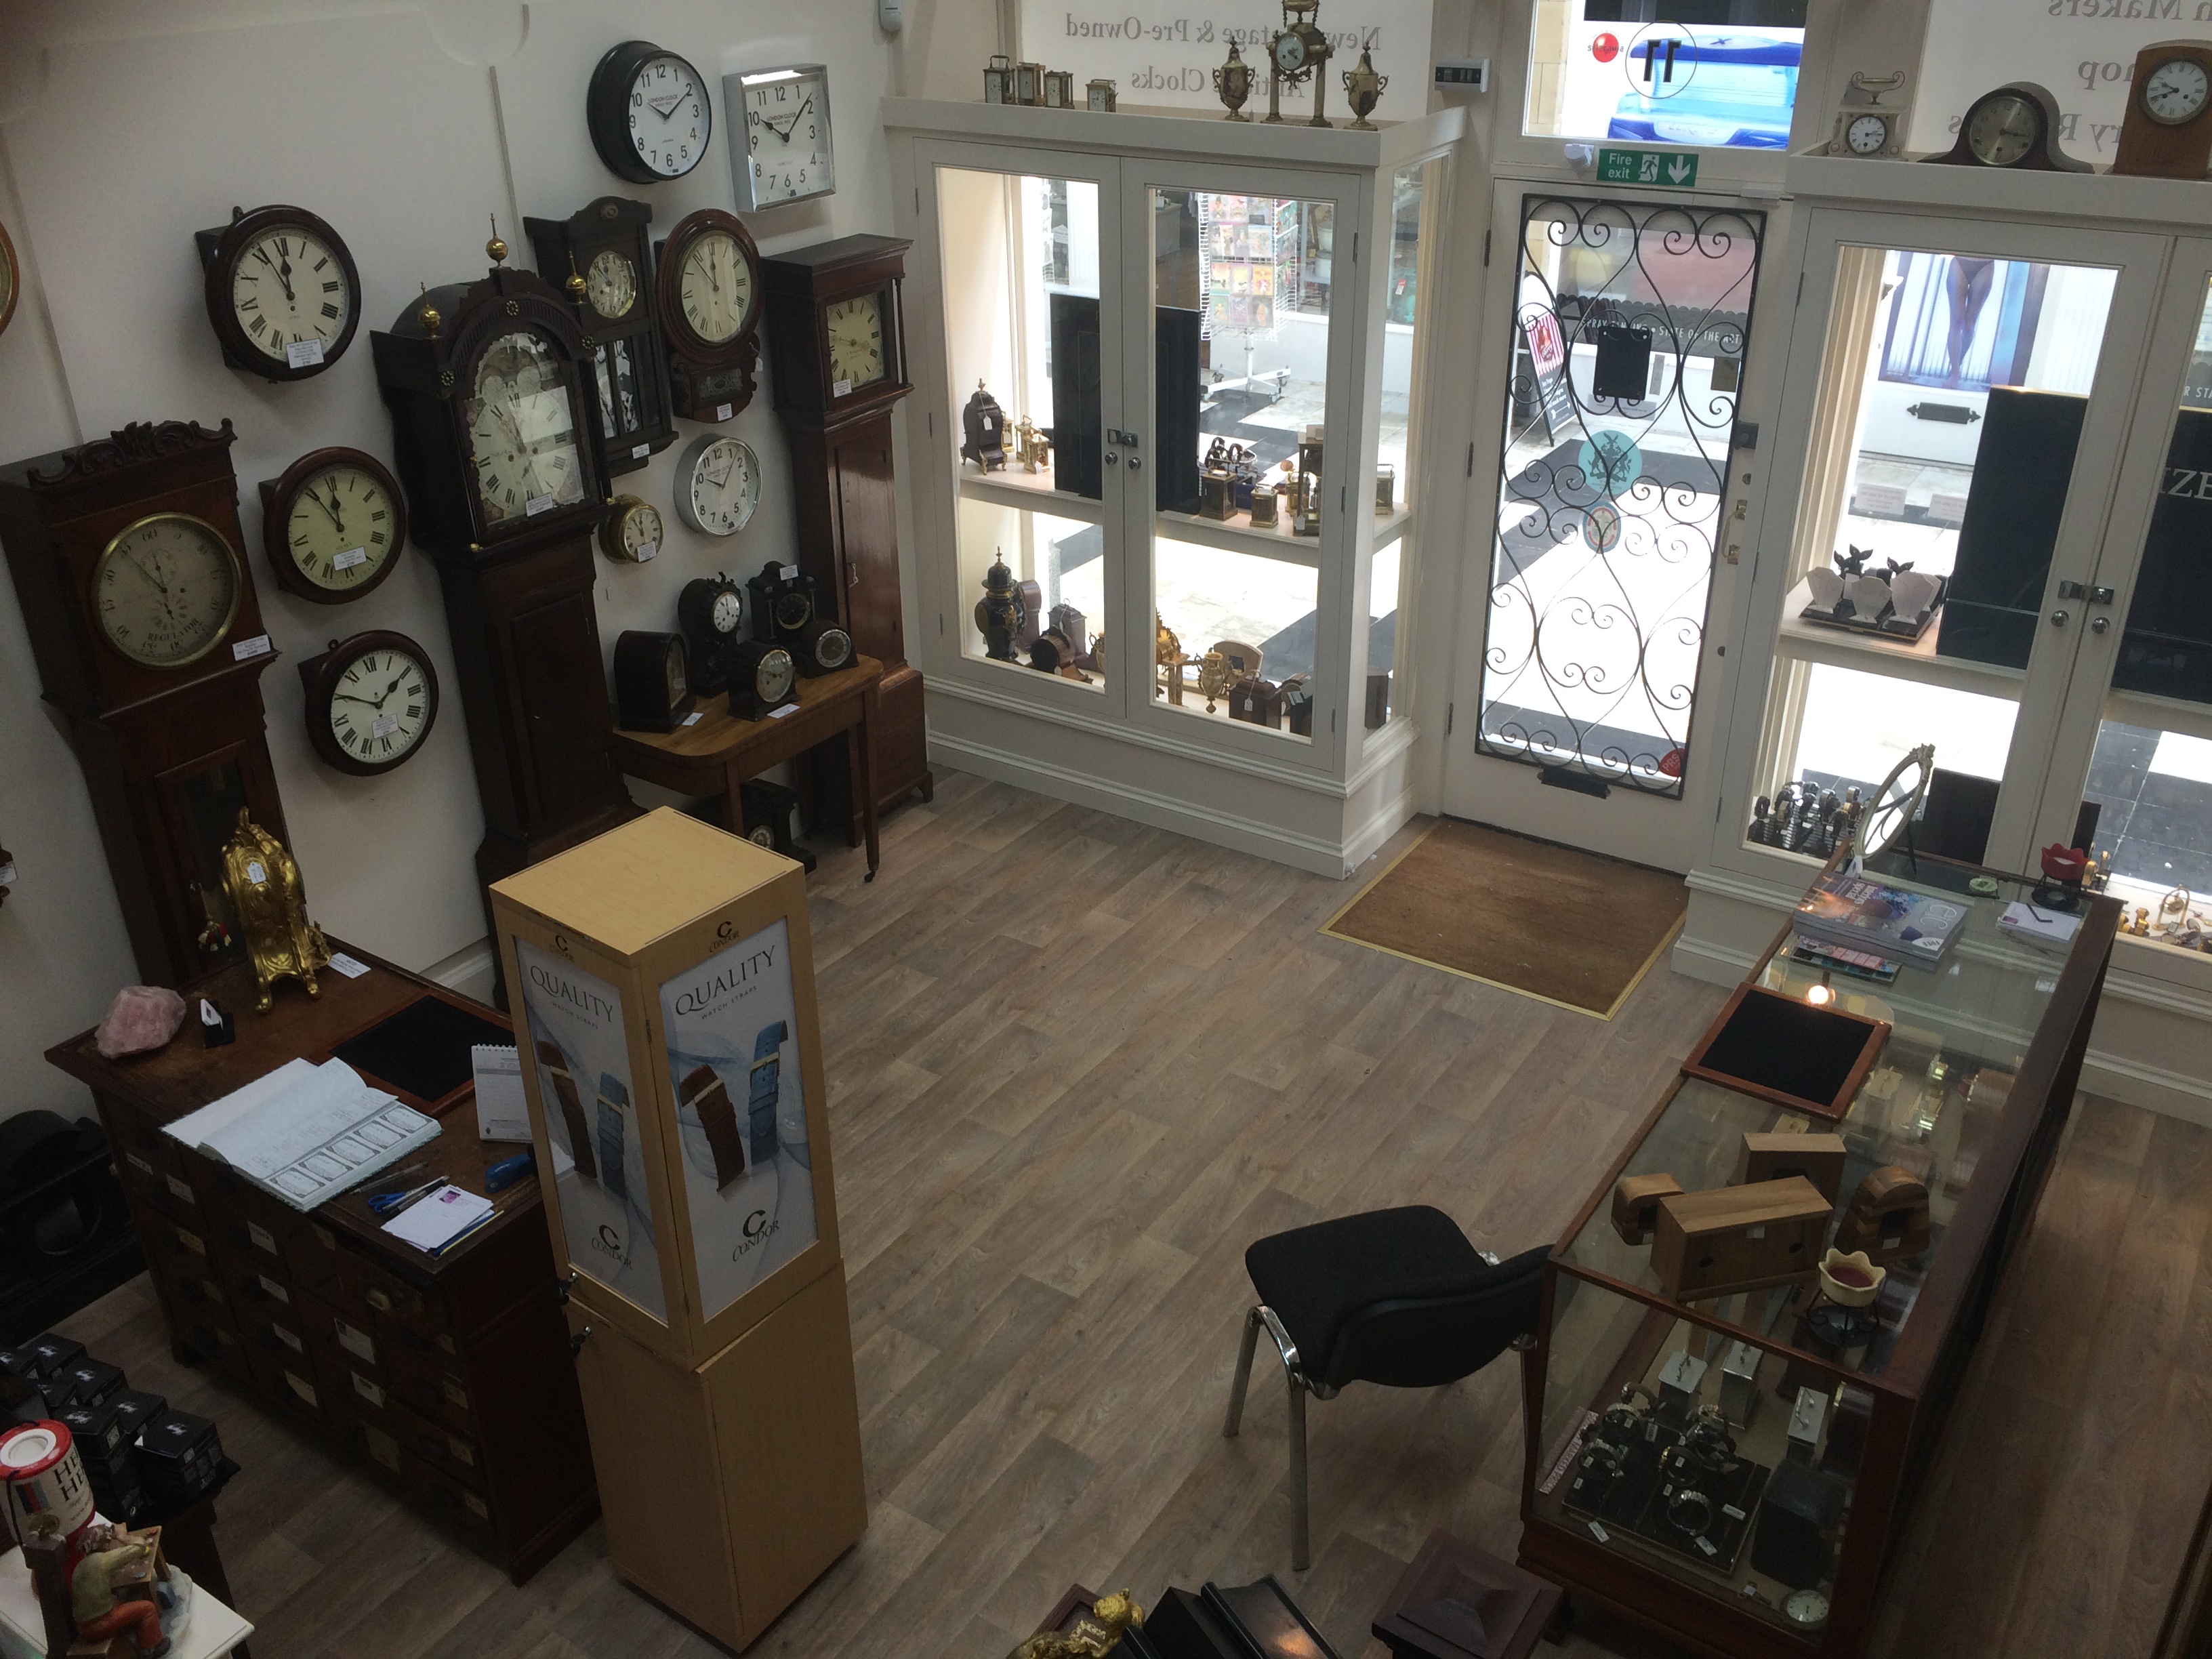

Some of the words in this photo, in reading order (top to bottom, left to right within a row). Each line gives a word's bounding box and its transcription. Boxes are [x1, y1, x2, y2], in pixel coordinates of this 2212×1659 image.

[766, 114, 783, 122] LONDON
[1609, 152, 1633, 165] Fire
[1607, 167, 1630, 179] exit
[1659, 327, 1684, 338] STTE
[1704, 331, 1719, 342] THE
[710, 930, 739, 953] CONDOR
[1922, 937, 1941, 947] FREE
[676, 945, 775, 1015] QUALITY
[531, 966, 613, 1023] QUALITY
[701, 1002, 727, 1020] WATCH
[731, 985, 757, 1004] STRAPS
[552, 1002, 573, 1016] WATCH
[577, 1015, 598, 1029] STRAPS
[743, 1210, 766, 1237] C
[598, 1224, 620, 1250] C
[733, 1220, 779, 1262] CONDOR
[591, 1237, 633, 1270] CONDOR
